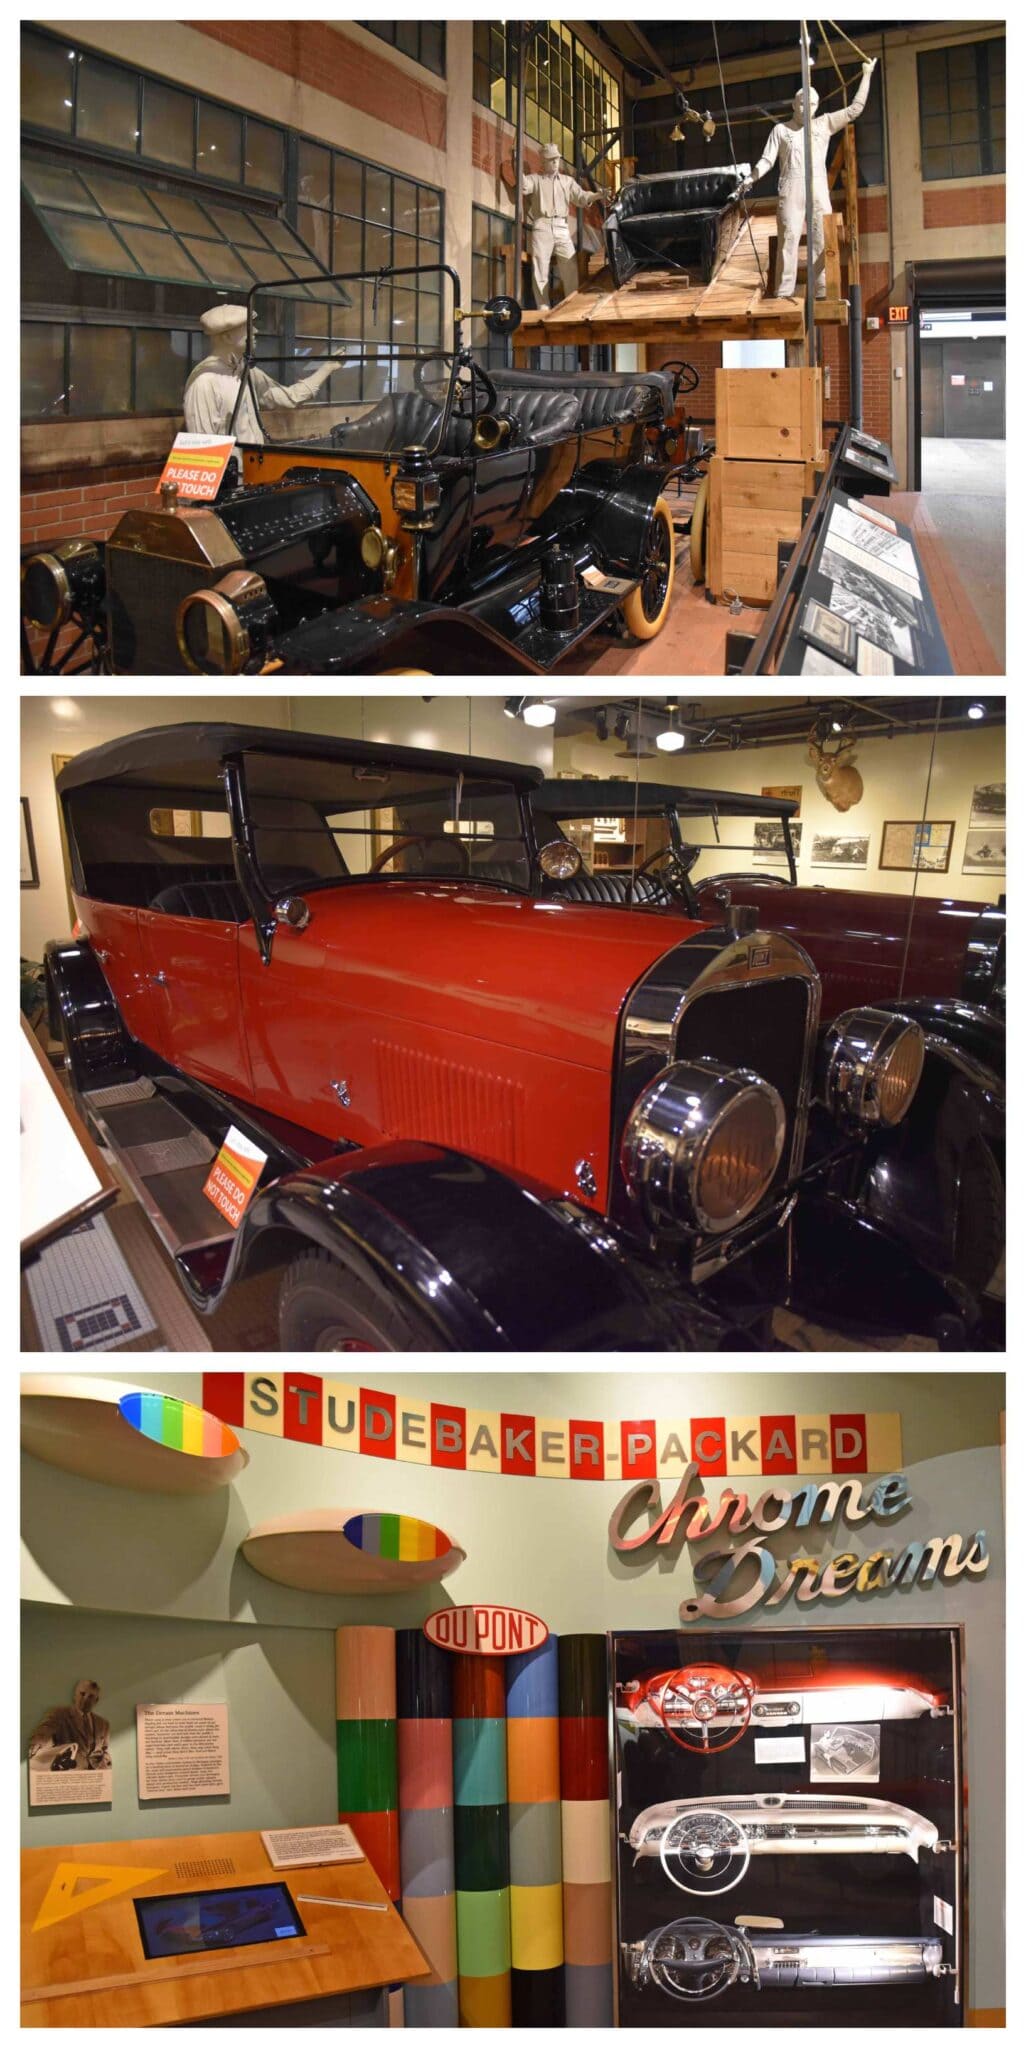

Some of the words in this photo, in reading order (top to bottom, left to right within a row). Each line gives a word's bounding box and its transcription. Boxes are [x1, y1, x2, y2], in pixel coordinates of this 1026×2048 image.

[889, 307, 909, 320] EXIT
[167, 468, 200, 481] PLEASE
[200, 471, 217, 483] DO
[181, 483, 214, 496] TOUCH
[206, 1180, 220, 1198] NOT
[217, 1191, 240, 1220] TOUCH
[213, 1167, 235, 1194] PLEASE
[232, 1187, 245, 1204] DO
[608, 1461, 914, 1552] Chrome
[678, 1528, 989, 1622] Dreams
[474, 1609, 538, 1651] PONT
